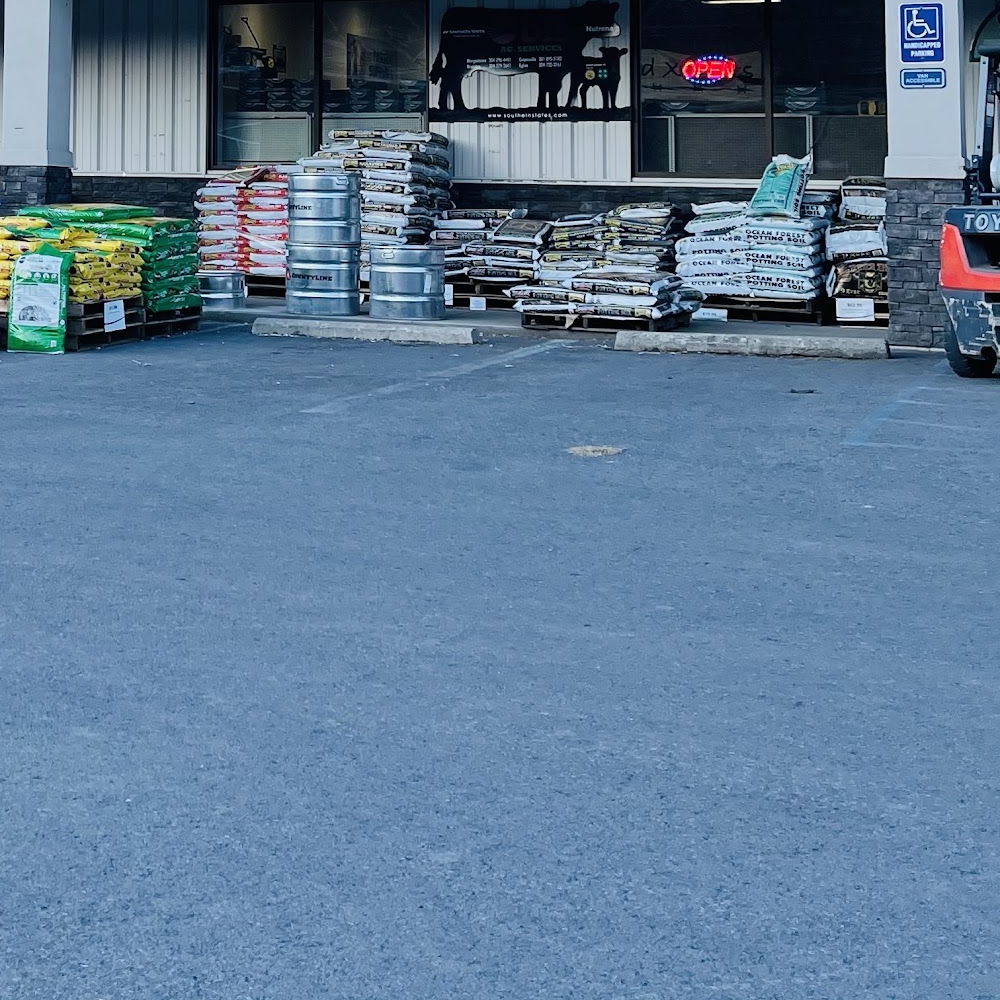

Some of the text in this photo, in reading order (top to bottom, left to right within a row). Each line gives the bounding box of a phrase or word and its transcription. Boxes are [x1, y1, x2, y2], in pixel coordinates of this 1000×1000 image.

[903, 41, 941, 49] HANDICAPPED
[682, 60, 736, 79] OPEN
[776, 231, 806, 239] FOREST
[745, 252, 772, 260] OCEAN
[746, 257, 804, 269] POTTING SOIL
[745, 274, 805, 285] OCEAN FOREST
[747, 280, 784, 288] POTTING
